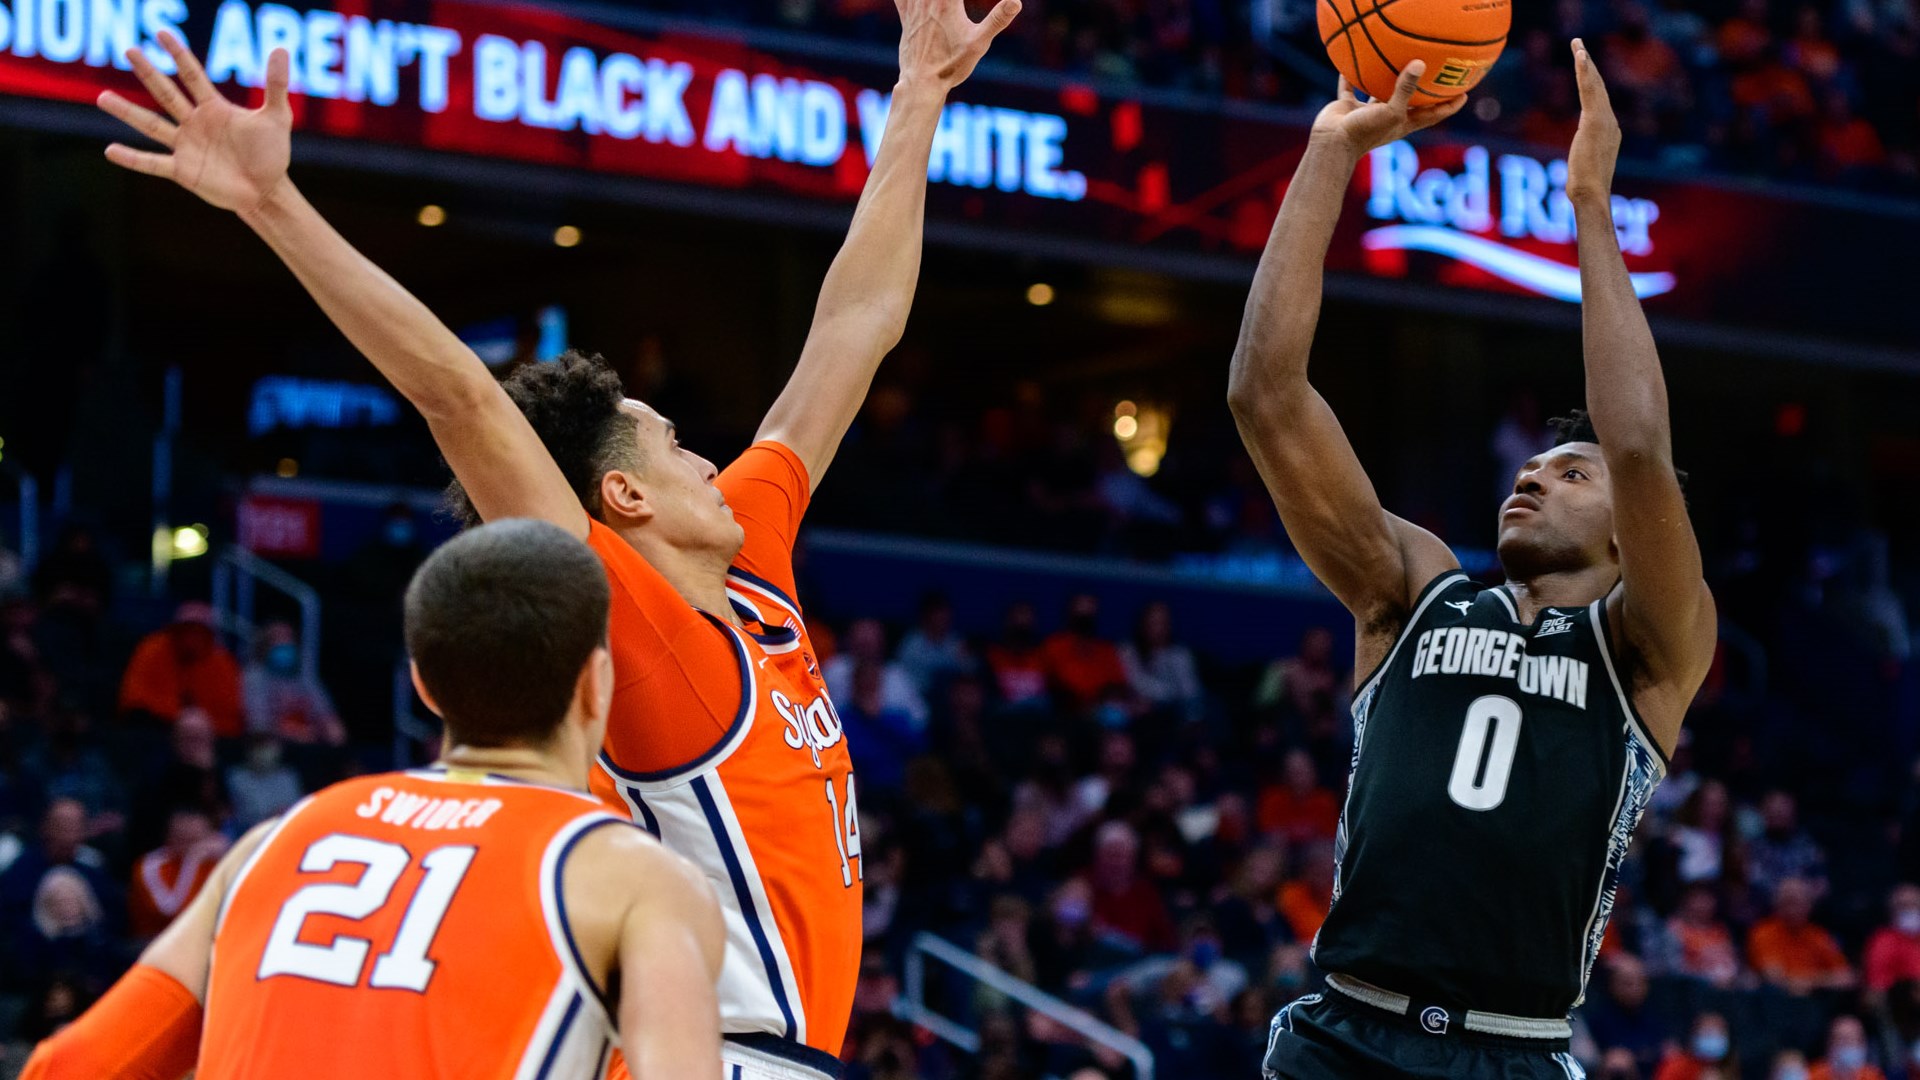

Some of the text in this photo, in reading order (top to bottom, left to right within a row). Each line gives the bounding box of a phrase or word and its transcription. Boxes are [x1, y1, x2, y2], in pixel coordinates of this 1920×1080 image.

[0, 0, 189, 75] IONS
[205, 0, 460, 112] AREN'T
[474, 33, 695, 146] BLACK
[703, 67, 846, 166] AND
[1368, 139, 1660, 257] Red Rier
[1411, 626, 1589, 710] GEORGEOWN
[1537, 622, 1574, 635] EAST
[1541, 616, 1567, 627] BIG
[356, 786, 503, 830] SWIDER
[1447, 694, 1523, 812] 0
[825, 771, 863, 888] 14
[256, 832, 479, 994] 21
